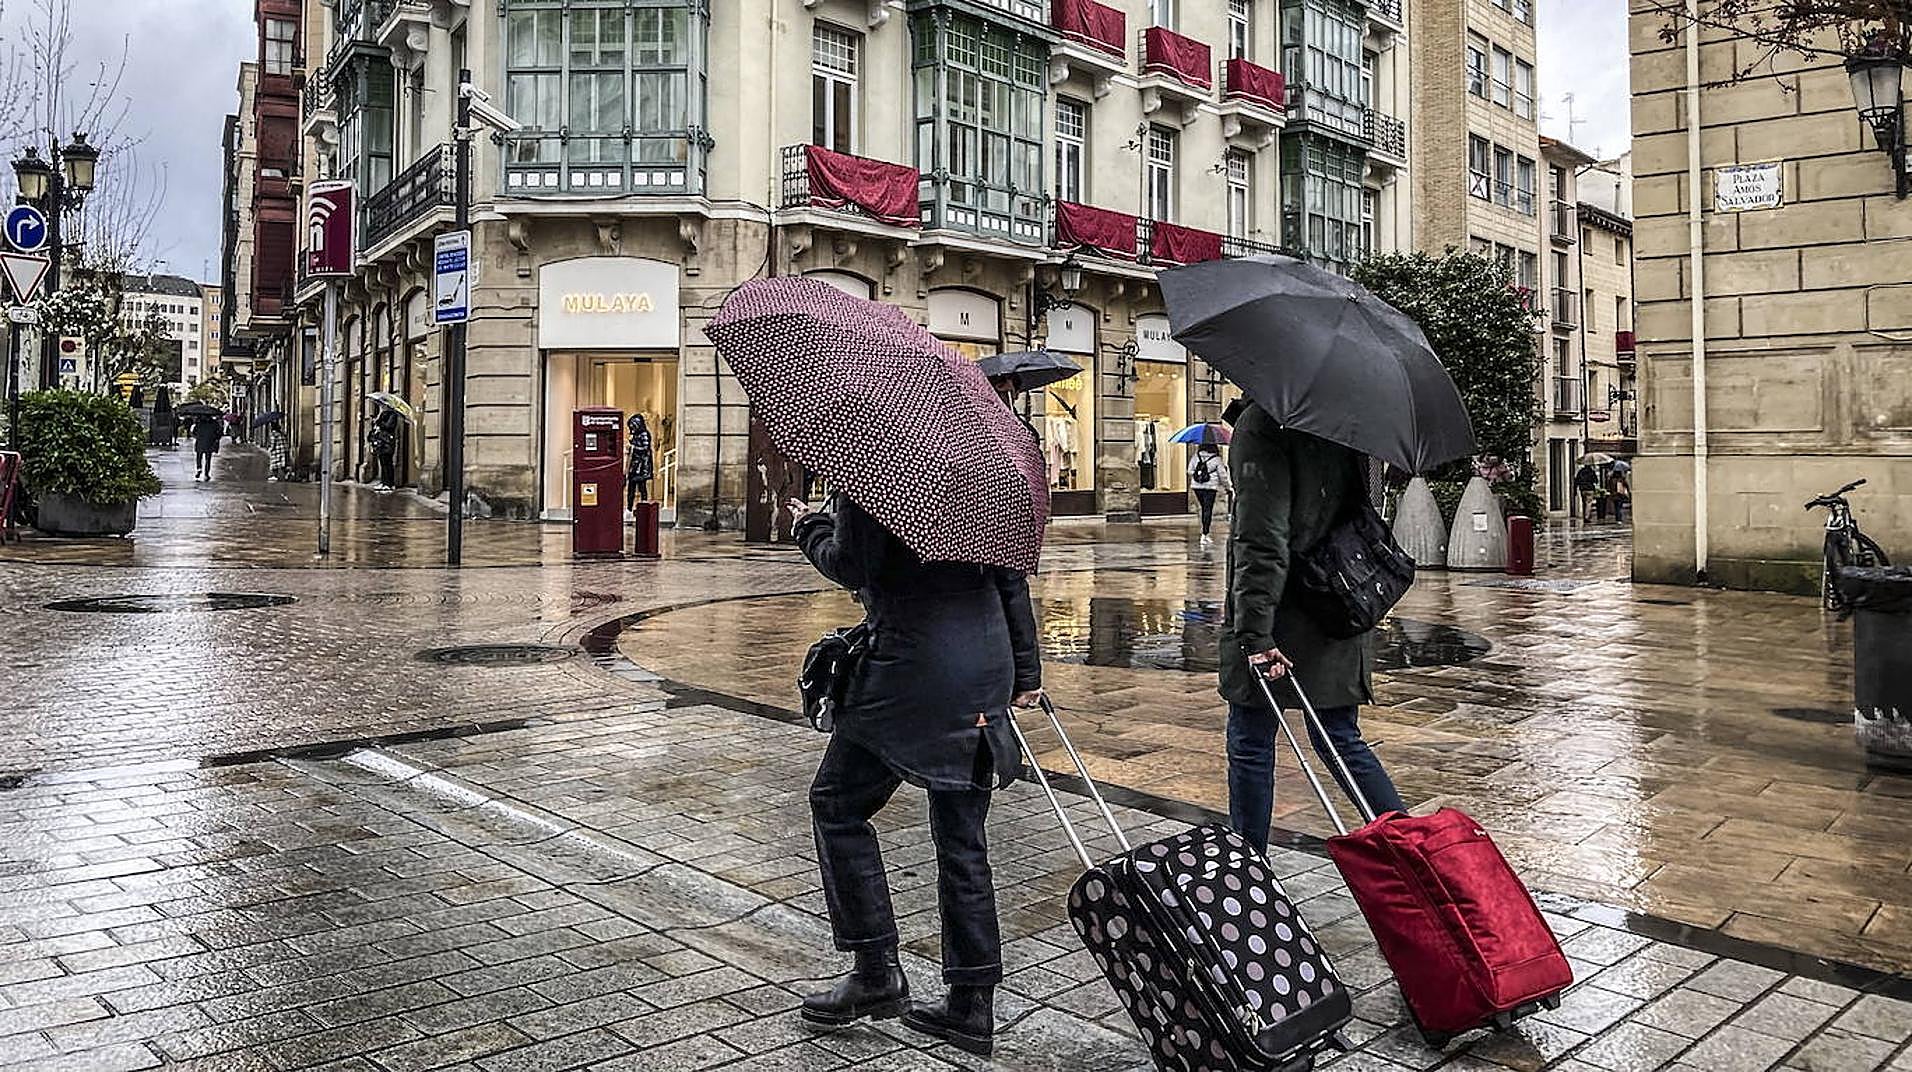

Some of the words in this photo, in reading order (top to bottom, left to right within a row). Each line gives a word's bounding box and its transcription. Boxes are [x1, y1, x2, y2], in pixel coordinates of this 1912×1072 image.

[1733, 173, 1765, 184] PLAZA
[1721, 194, 1775, 206] SALVADOR
[563, 294, 651, 312] MULAYA
[960, 312, 970, 326] M
[1065, 319, 1073, 331] M
